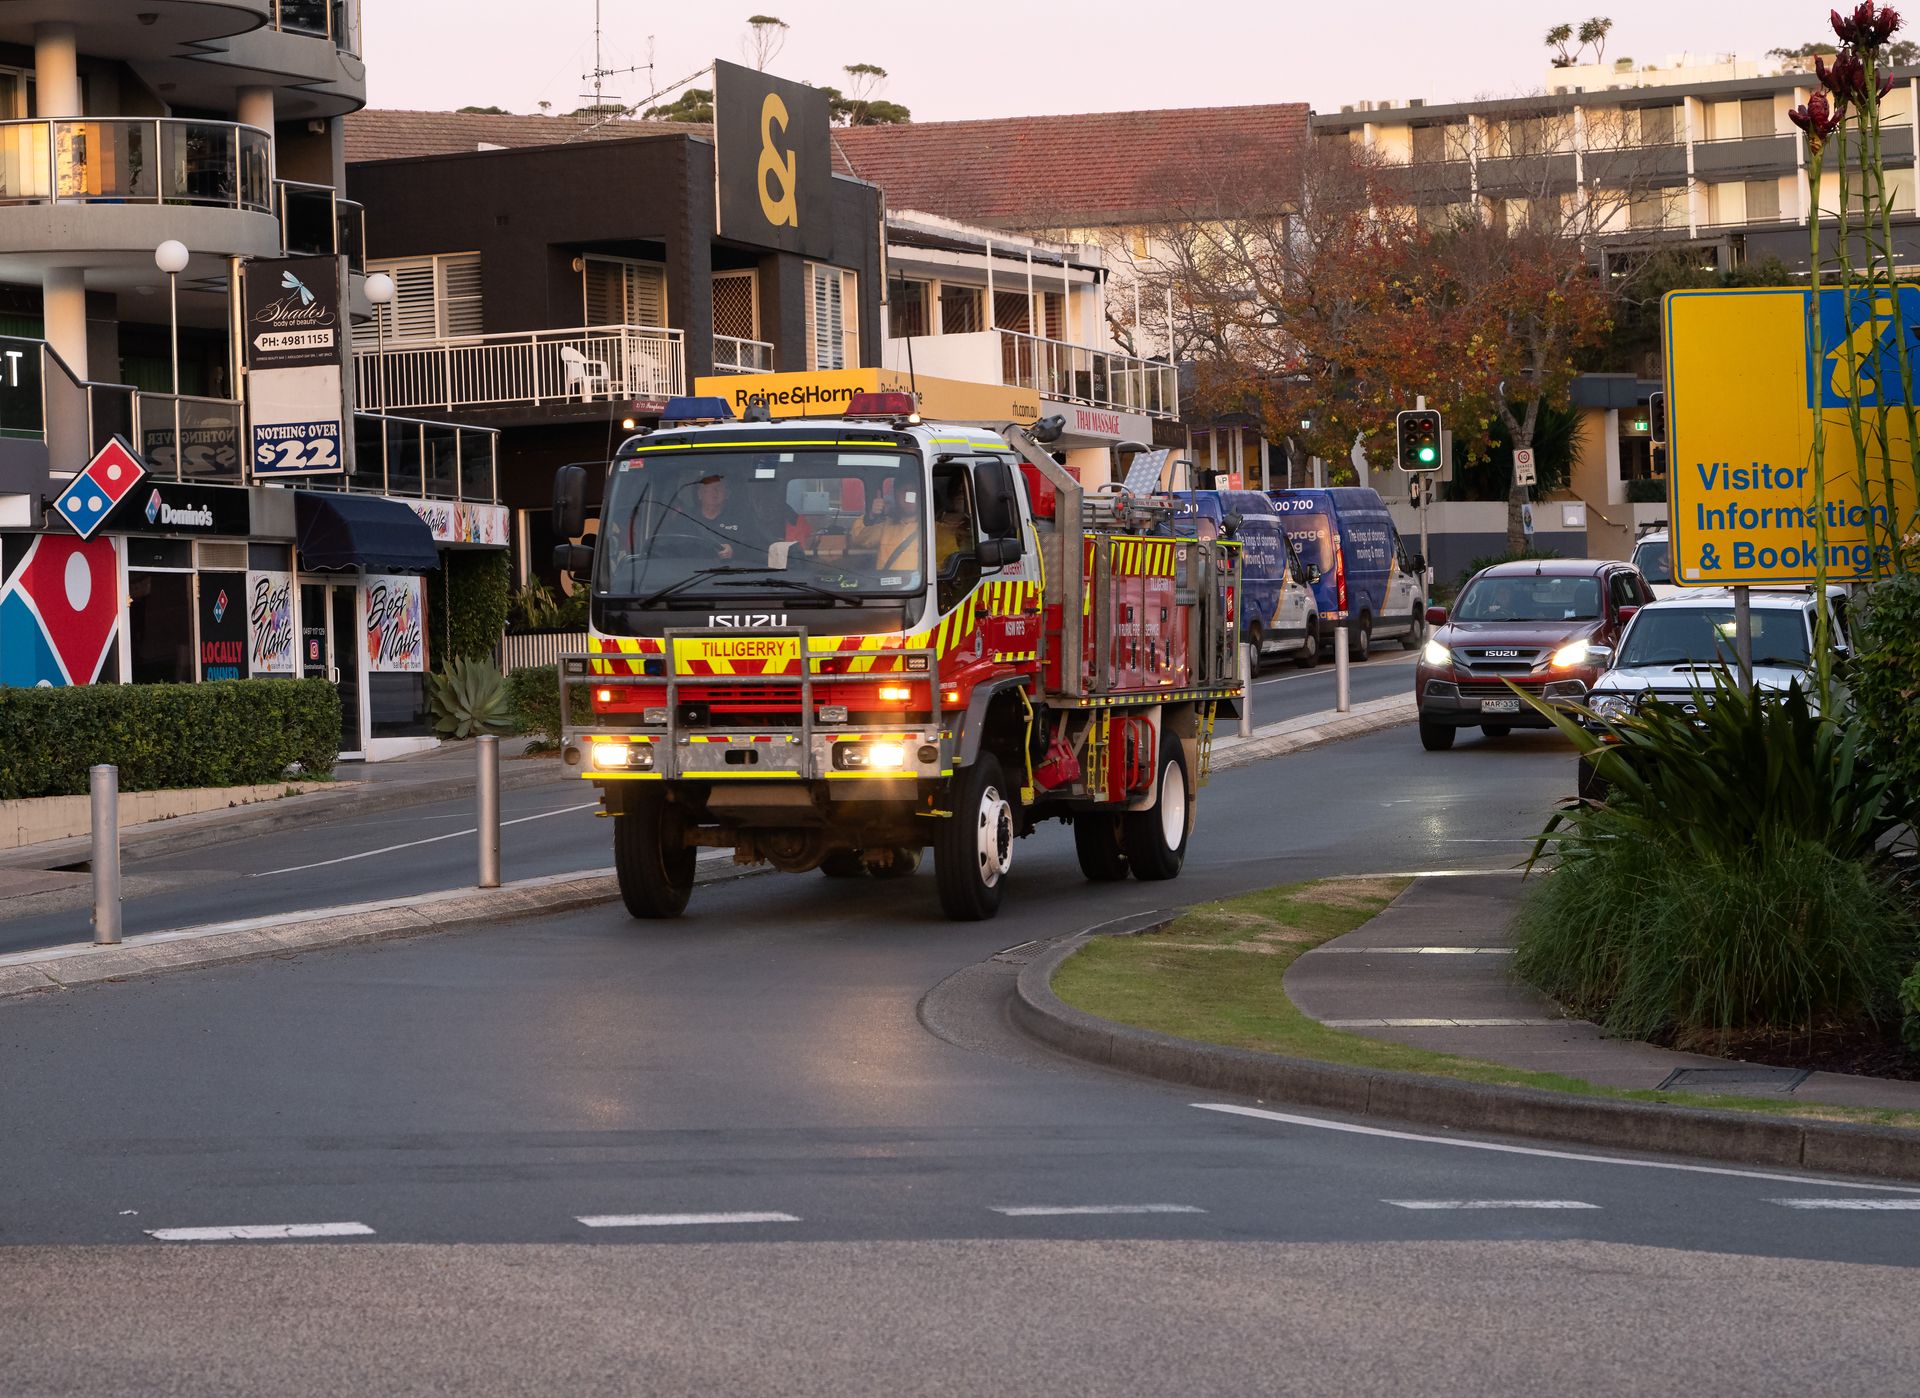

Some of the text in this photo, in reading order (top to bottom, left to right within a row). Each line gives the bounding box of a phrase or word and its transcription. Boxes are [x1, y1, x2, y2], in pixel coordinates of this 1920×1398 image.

[254, 297, 336, 325] Shades
[262, 333, 329, 347] PH: 4981 1155
[1012, 401, 1038, 418] rh.com.au
[256, 424, 338, 440] NOTHING OVER
[1076, 410, 1120, 435] THAI MASSAGE
[257, 438, 337, 469] $22
[1697, 461, 1808, 490] Visitor
[161, 504, 213, 526] Domino's
[1292, 499, 1314, 510] 700
[1697, 499, 1887, 530] Information
[1700, 540, 1890, 573] & Bookings
[251, 578, 289, 625] Best
[368, 585, 408, 631] Best
[709, 614, 787, 628] ISUZU
[1005, 621, 1015, 636] NSW
[202, 641, 243, 664] LOCALLY
[253, 618, 292, 663] Nails
[379, 621, 421, 664] Nails
[702, 641, 796, 657] TILLIGERRY 1
